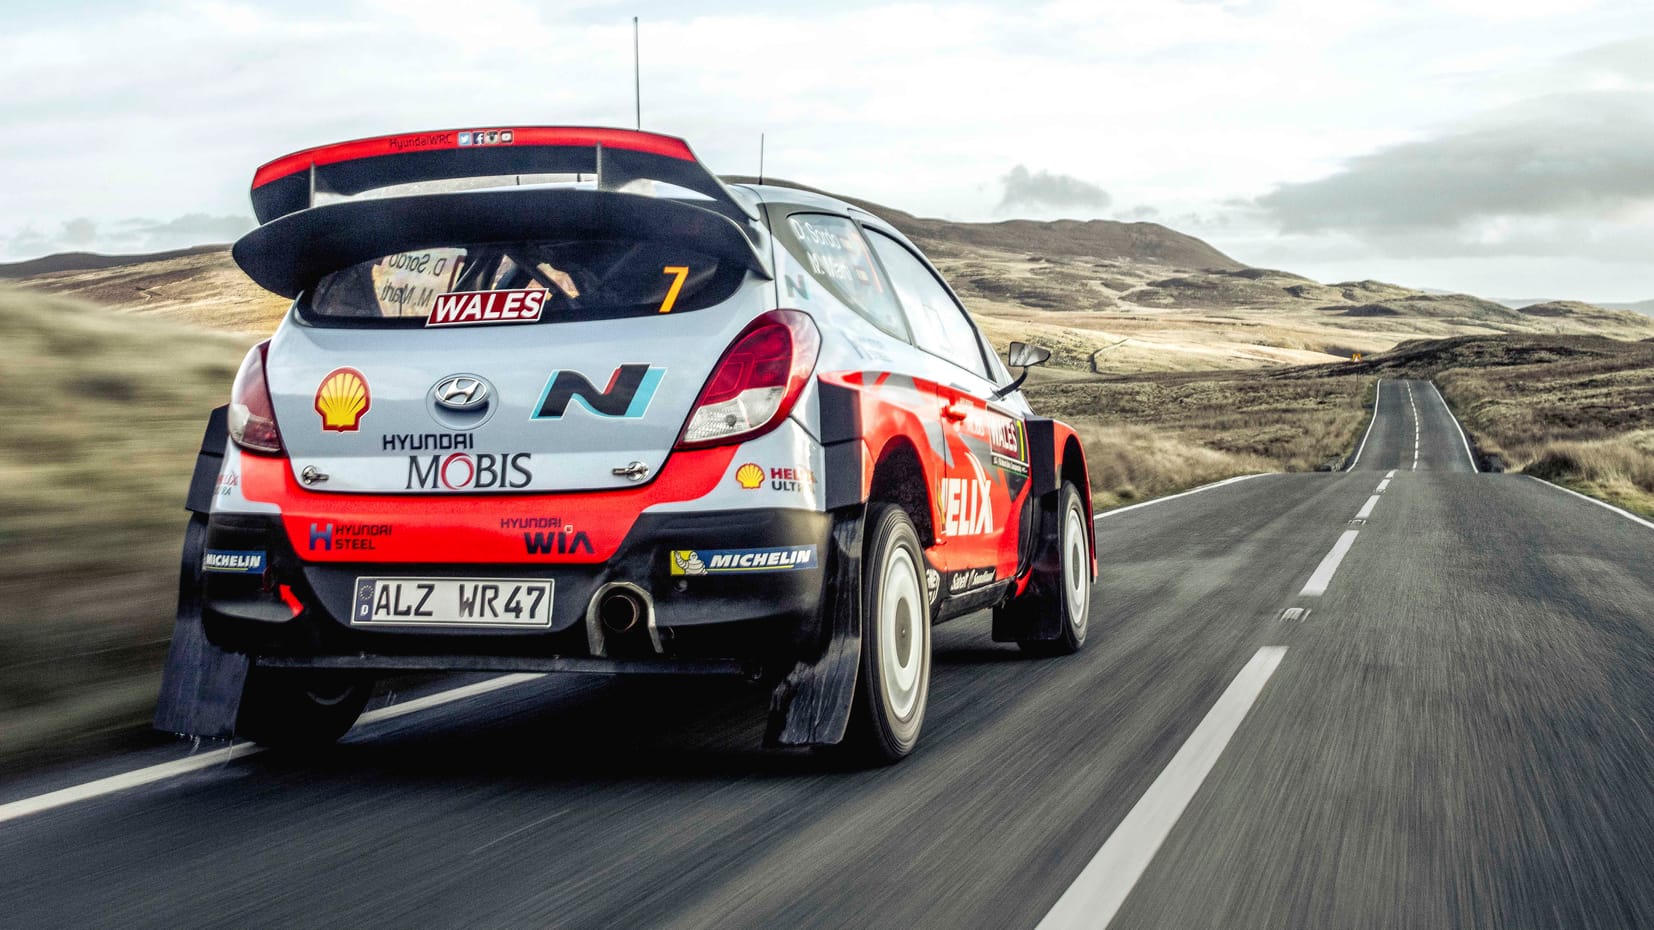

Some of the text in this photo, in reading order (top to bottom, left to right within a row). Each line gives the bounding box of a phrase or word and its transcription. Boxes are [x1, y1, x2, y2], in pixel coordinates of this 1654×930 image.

[390, 134, 453, 150] HyundaiWRC
[659, 266, 689, 313] 7
[435, 291, 543, 323] WALES
[382, 433, 474, 451] HYUNDAI
[405, 452, 533, 490] MOBIS
[770, 467, 817, 484] HEL
[941, 452, 994, 537] ELIX
[335, 524, 392, 536] HYUNDAI
[500, 518, 562, 529] HYUNDAI
[335, 538, 376, 550] STEEL
[206, 554, 261, 568] MICHELIN
[710, 550, 812, 569] MICHELIN
[374, 584, 436, 617] ALZ
[360, 604, 369, 616] D
